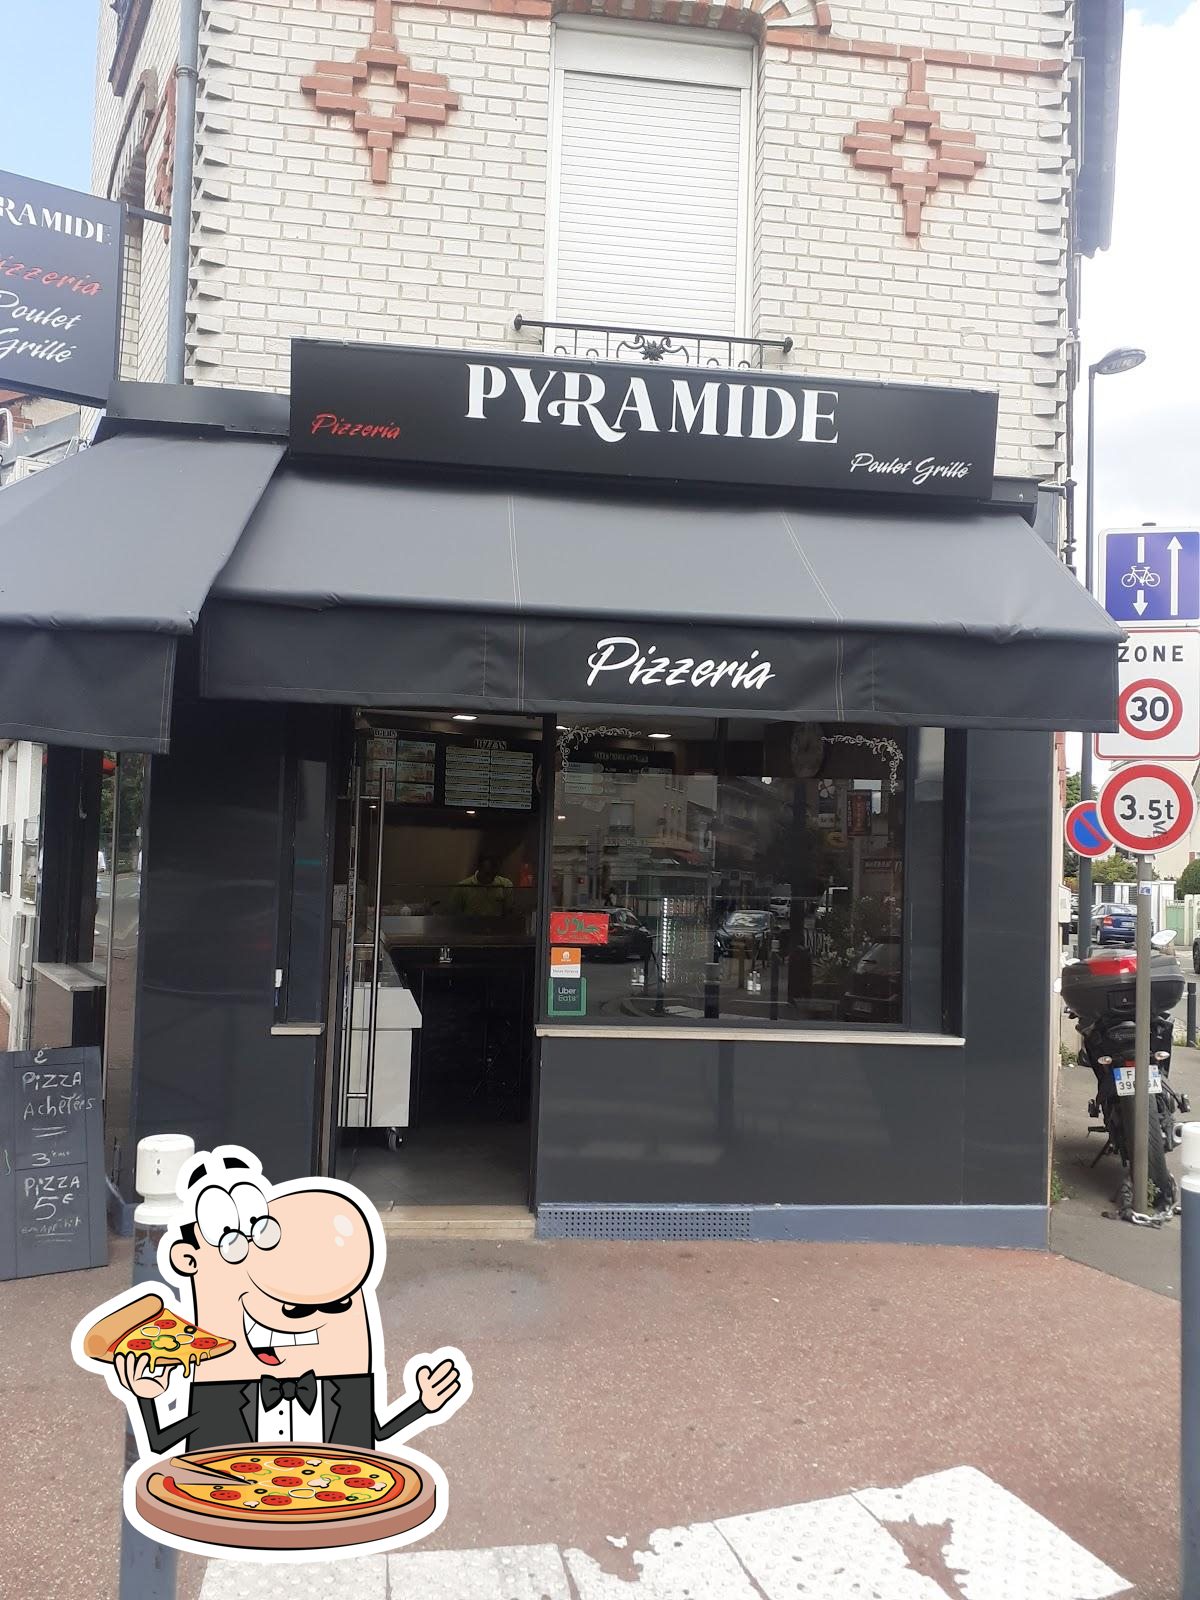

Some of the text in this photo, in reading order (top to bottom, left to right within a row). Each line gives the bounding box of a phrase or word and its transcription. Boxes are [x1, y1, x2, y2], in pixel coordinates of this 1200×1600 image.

[464, 363, 839, 443] PYRAMIDE
[311, 413, 401, 440] Pizzeria
[850, 452, 972, 485] Poulet Grillé
[587, 636, 776, 690] Pizzeria
[1118, 644, 1184, 662] ZONE
[1129, 696, 1169, 722] 30
[1119, 794, 1174, 820] 3.5t
